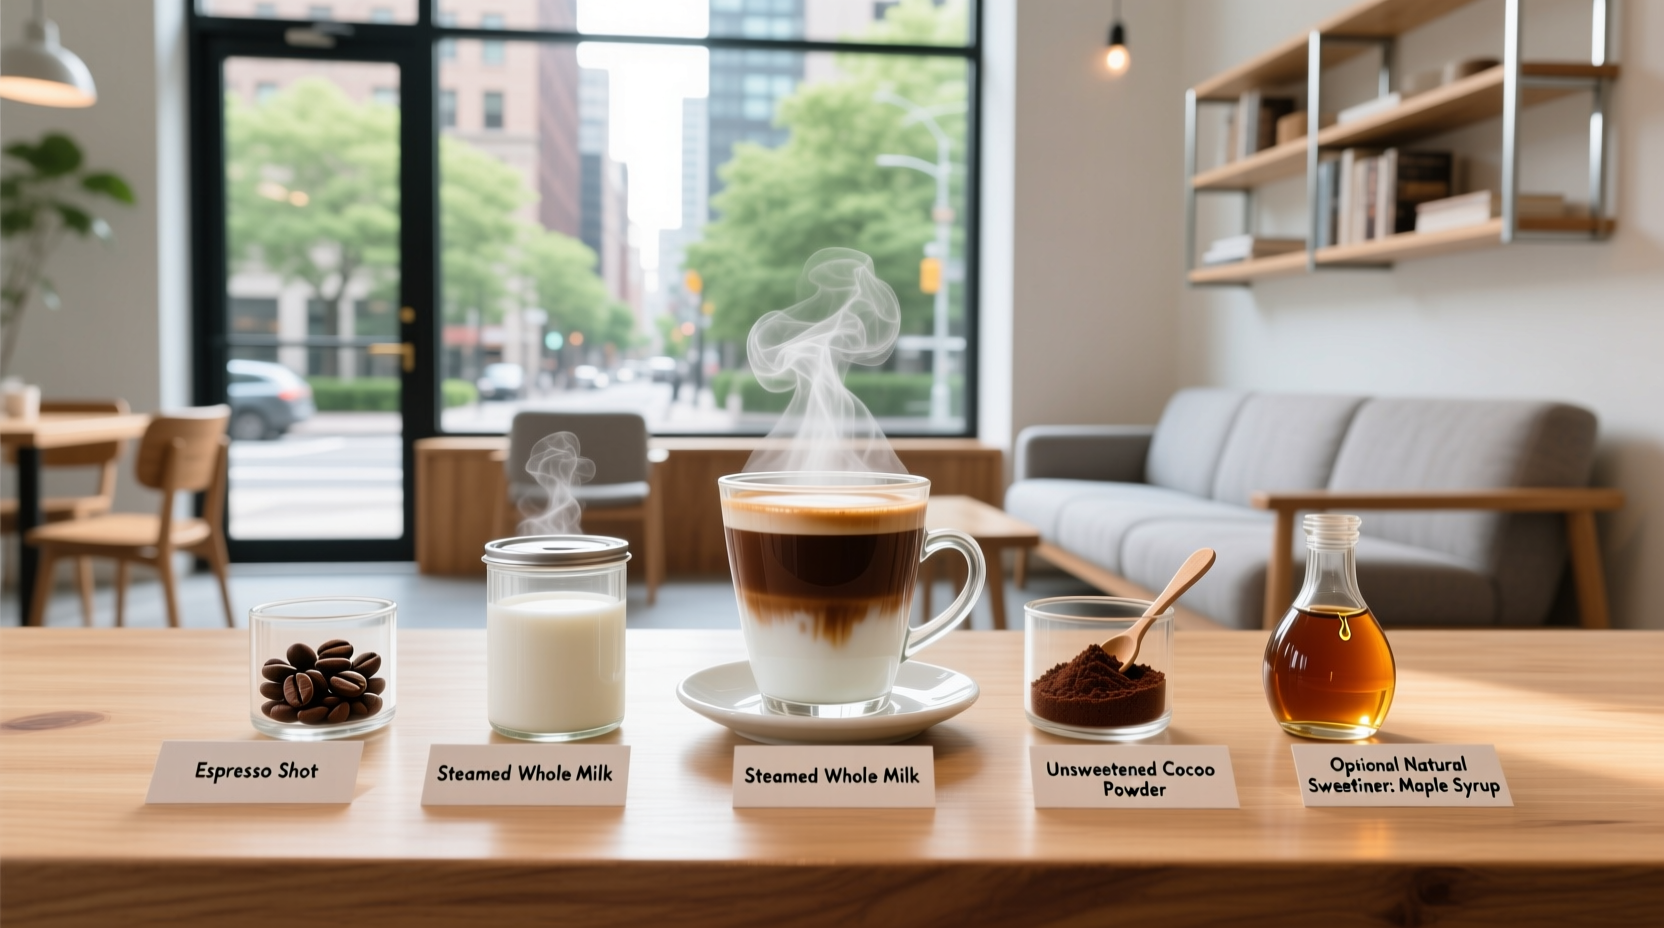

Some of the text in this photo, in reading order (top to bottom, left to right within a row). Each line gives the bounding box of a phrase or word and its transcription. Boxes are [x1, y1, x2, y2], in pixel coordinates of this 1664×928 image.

[194, 760, 319, 785] Espresso Shot
[437, 763, 613, 782] Steamed Whole Milk
[744, 765, 920, 784] Steamed Whole Milk
[1046, 761, 1157, 777] Unsweetened
[1330, 755, 1468, 777] Optional Natural
[1103, 780, 1167, 798] Powder
[1399, 777, 1449, 799] Maple
[1452, 777, 1501, 799] Syrup
